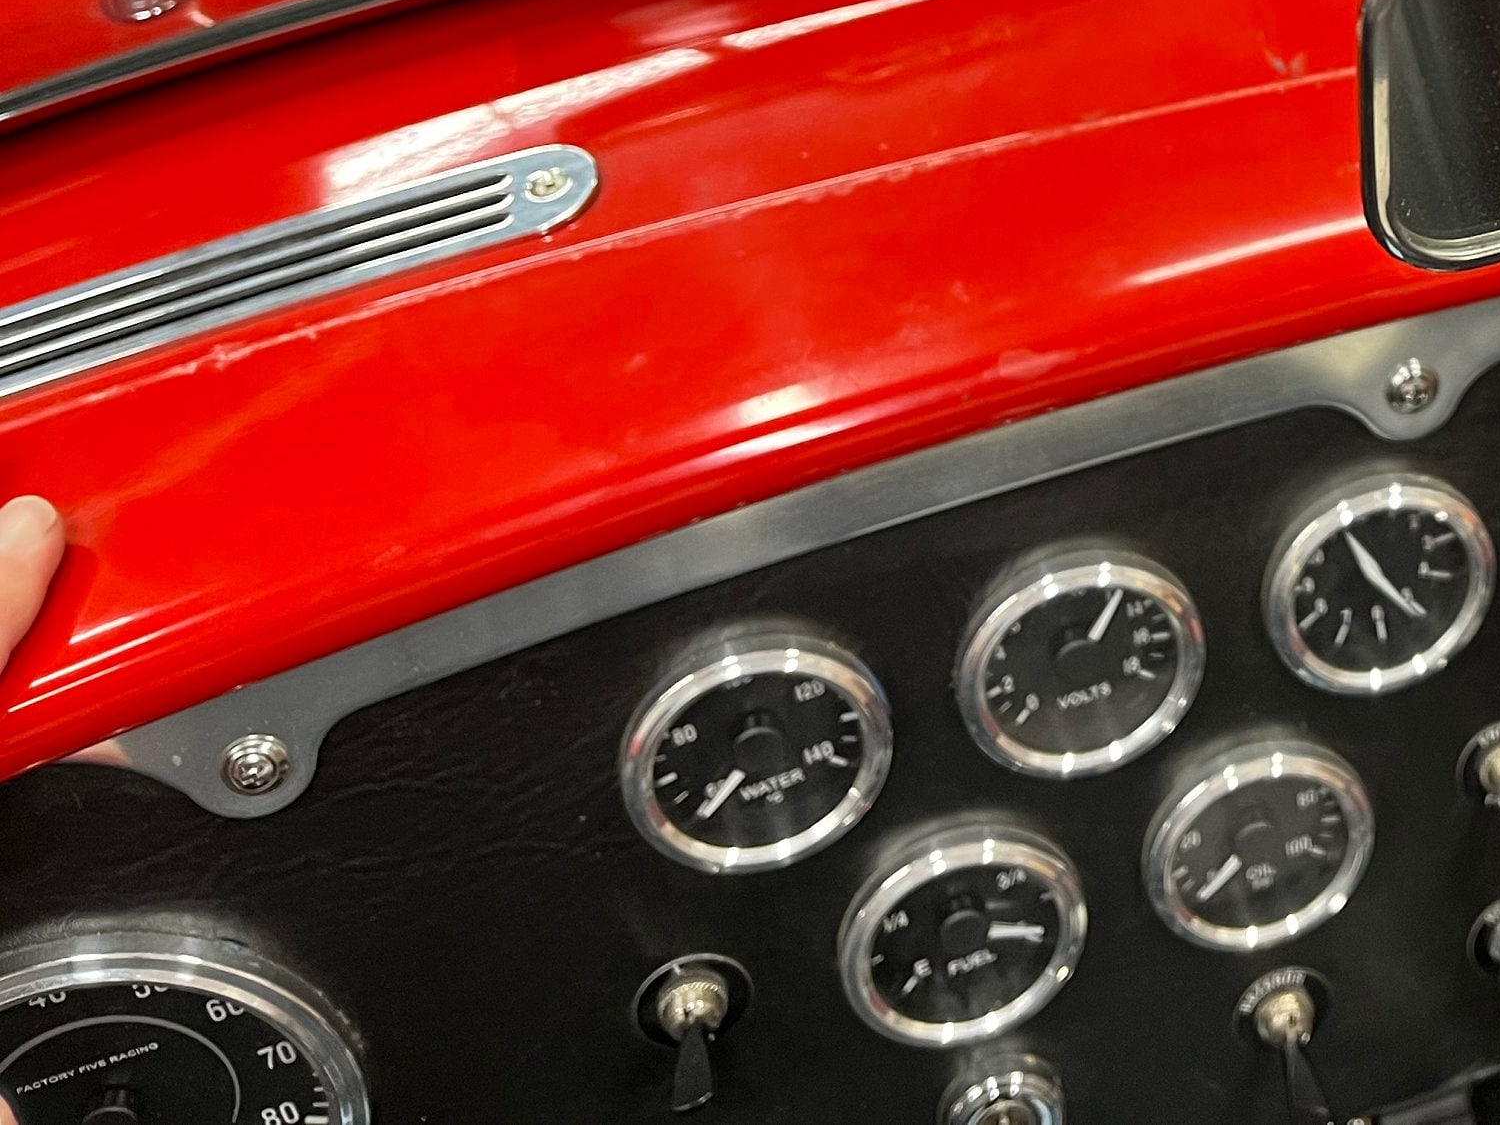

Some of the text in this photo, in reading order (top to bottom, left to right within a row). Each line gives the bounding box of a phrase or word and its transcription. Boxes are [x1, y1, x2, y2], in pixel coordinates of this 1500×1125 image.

[795, 679, 826, 702] 120
[1057, 681, 1112, 711] VOLTS
[804, 740, 834, 765] 140
[740, 767, 805, 801] WATER
[913, 957, 933, 977] E
[949, 948, 998, 976] FUEL
[16, 1042, 159, 1095] FACTORY FIVE RACING
[257, 1040, 297, 1070] 70
[261, 1101, 300, 1125] 80
